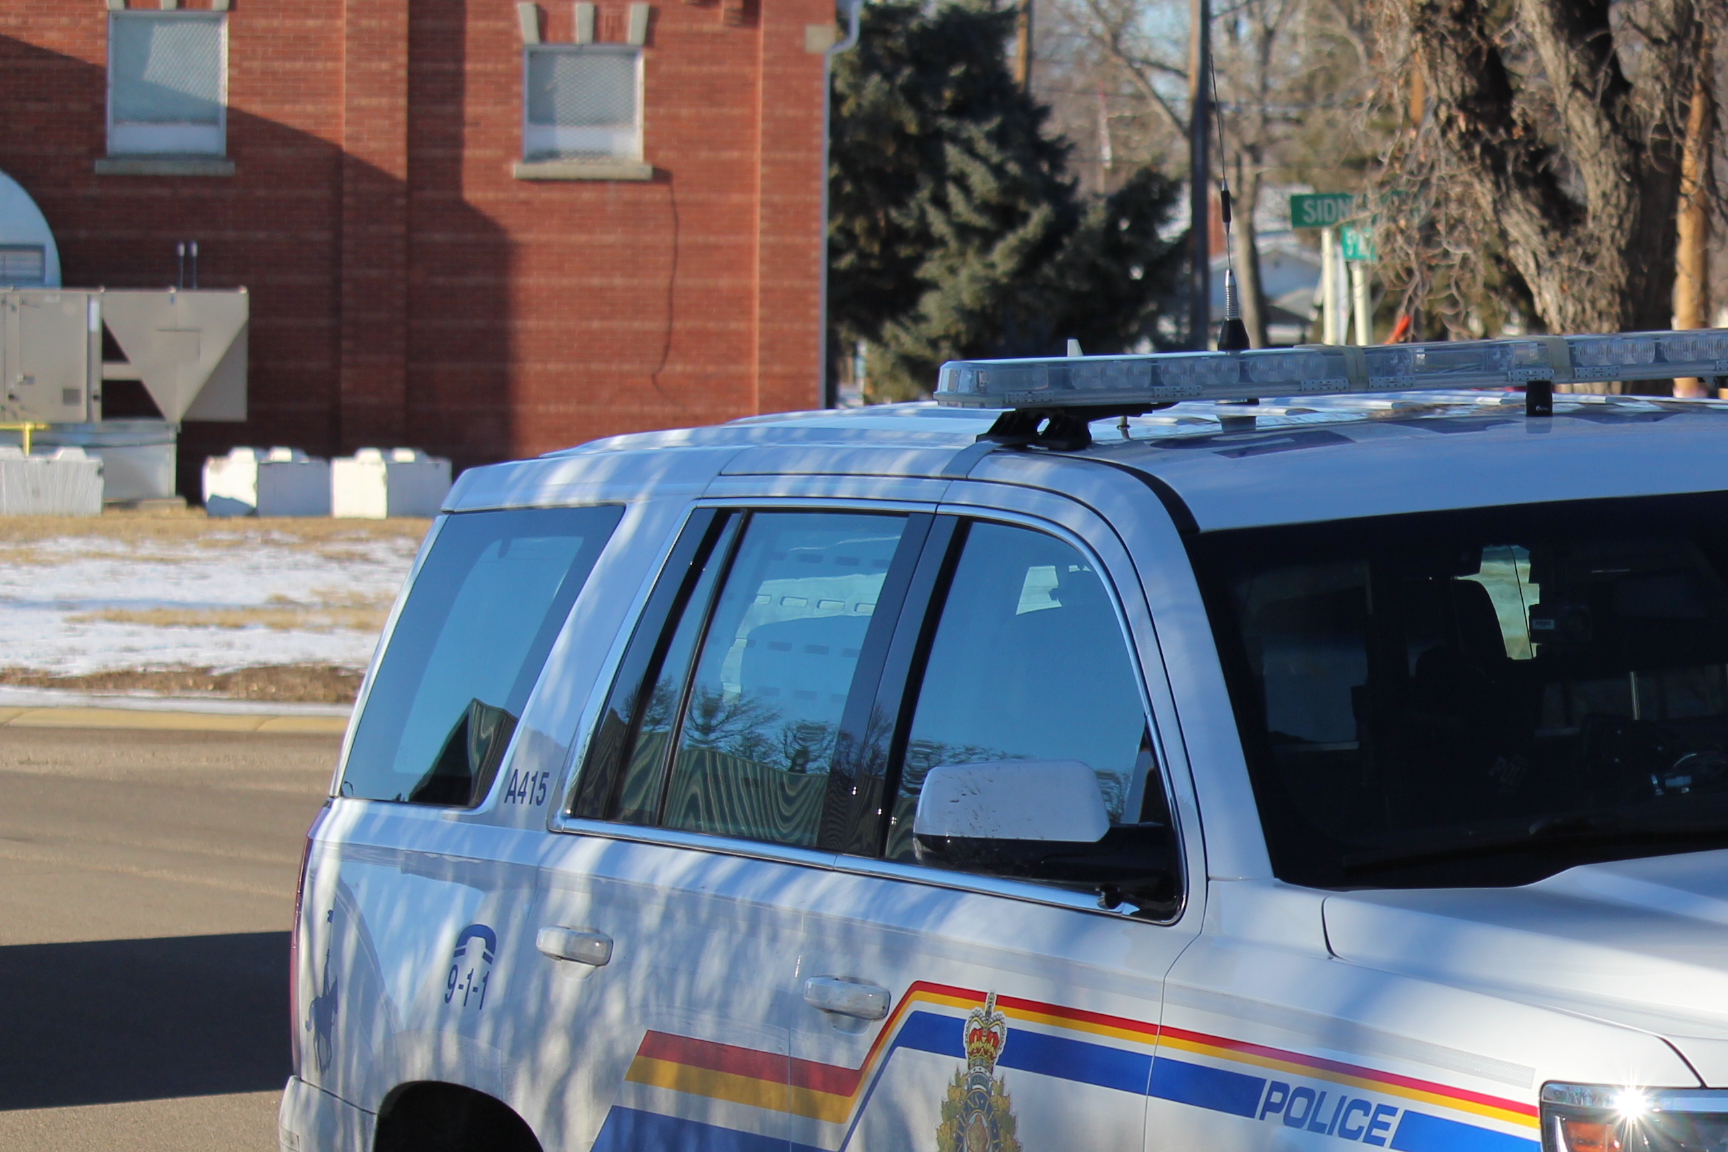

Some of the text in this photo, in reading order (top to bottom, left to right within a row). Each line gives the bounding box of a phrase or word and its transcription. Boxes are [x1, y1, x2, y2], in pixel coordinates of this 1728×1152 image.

[1302, 196, 1357, 224] SIDN
[504, 767, 550, 807] A415
[444, 963, 491, 1010] 9-1-1
[1258, 1080, 1399, 1147] POLICE
